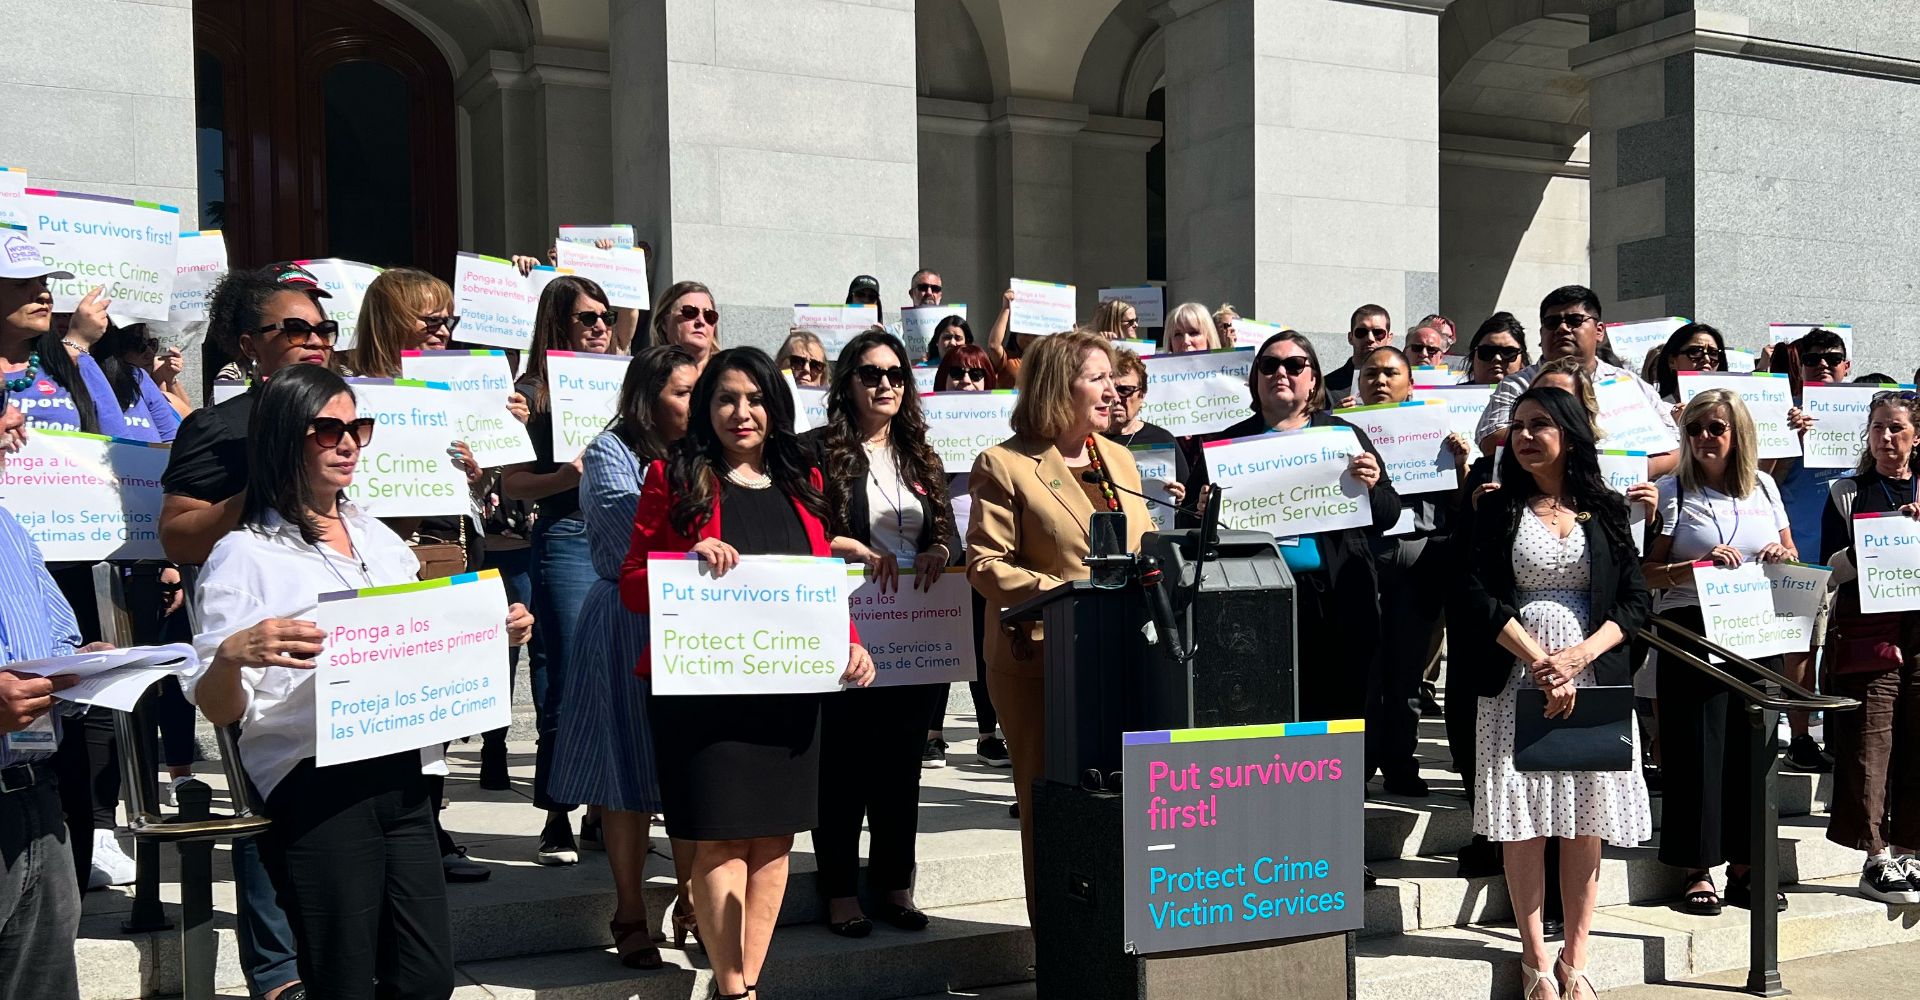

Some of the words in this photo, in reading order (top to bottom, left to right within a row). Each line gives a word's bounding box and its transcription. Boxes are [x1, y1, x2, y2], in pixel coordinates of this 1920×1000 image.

[38, 215, 69, 233] Put
[74, 221, 143, 241] survivors
[146, 225, 172, 245] first!
[119, 262, 159, 284] Crime
[176, 261, 219, 276] primero!
[505, 276, 518, 289] los
[110, 281, 163, 305] Services
[170, 289, 202, 299] rvicios
[462, 283, 526, 301] sobrevivientes
[180, 301, 211, 310] Crime
[461, 308, 493, 322] Proteja
[496, 312, 509, 324] los
[460, 320, 473, 331] las
[515, 326, 528, 338] de
[482, 374, 508, 390] first!
[559, 374, 584, 390] Put
[1146, 373, 1158, 385] ut
[1160, 369, 1217, 383] survivors
[1219, 364, 1249, 377] first!
[1196, 393, 1240, 408] Crime
[1762, 389, 1785, 402] first!
[946, 408, 998, 420] survivors
[1810, 400, 1829, 412] Put
[1834, 401, 1870, 412] survivo
[411, 407, 448, 427] first!
[466, 414, 503, 432] Crime
[562, 410, 608, 429] Prote
[1191, 406, 1252, 424] Services
[1367, 423, 1383, 434] los
[1809, 428, 1854, 441] Protect
[978, 434, 1008, 447] Crim
[1398, 429, 1442, 446] primero!
[1809, 444, 1847, 456] Victim
[4, 456, 43, 471] onga
[50, 457, 59, 466] a
[376, 453, 438, 474] Crime
[1217, 463, 1244, 478] Put
[1248, 453, 1318, 473] survivors
[1384, 458, 1427, 471] ervicios
[0, 472, 105, 486] obrevivientes
[1404, 471, 1443, 482] Crimen
[1610, 471, 1639, 487] first!
[368, 477, 455, 498] Services
[1221, 491, 1284, 515] Protect
[1290, 484, 1343, 502] Crime
[16, 511, 45, 527] teja
[52, 510, 74, 524] los
[80, 510, 152, 525] Servicios
[1283, 500, 1358, 522] Services
[91, 527, 111, 541] de
[118, 527, 159, 541] Crim
[1864, 533, 1889, 548] Put
[1867, 566, 1920, 582] Protec
[662, 582, 695, 601] Put
[701, 584, 790, 602] survivors
[796, 583, 837, 603] first!
[1706, 581, 1730, 596] Put
[1733, 579, 1779, 593] survivors
[1782, 575, 1816, 591] first!
[866, 596, 873, 605] a
[877, 592, 895, 605] los
[911, 606, 962, 622] primero!
[1712, 613, 1760, 631] Protect
[1762, 608, 1794, 625] Crime
[329, 625, 389, 648] ¡Ponga
[396, 623, 405, 636] a
[410, 617, 430, 634] los
[663, 629, 746, 650] Protect
[753, 629, 821, 650] Crime
[1758, 625, 1803, 643] Services
[330, 640, 444, 667] sobrevivientes
[447, 623, 499, 654] primero!
[867, 642, 885, 655] los
[888, 640, 942, 654] Servicios
[945, 642, 952, 651] a
[663, 654, 734, 675] Victim
[742, 654, 835, 675] Services
[895, 657, 911, 669] de
[915, 655, 960, 669] Crimen
[331, 694, 389, 717] Proteja
[395, 691, 416, 707] los
[421, 677, 479, 702] Servicios
[482, 675, 489, 687] a
[331, 723, 354, 740] las
[359, 713, 425, 735] Víctimas
[429, 705, 447, 723] de
[451, 694, 496, 717] Crimen
[1149, 760, 1201, 793] Put
[1209, 753, 1343, 790] survivors
[1147, 794, 1217, 831] first!
[1149, 863, 1246, 896] Protect
[1253, 855, 1329, 885] Crime
[1148, 898, 1234, 930] Victim
[1242, 888, 1345, 922] Services
